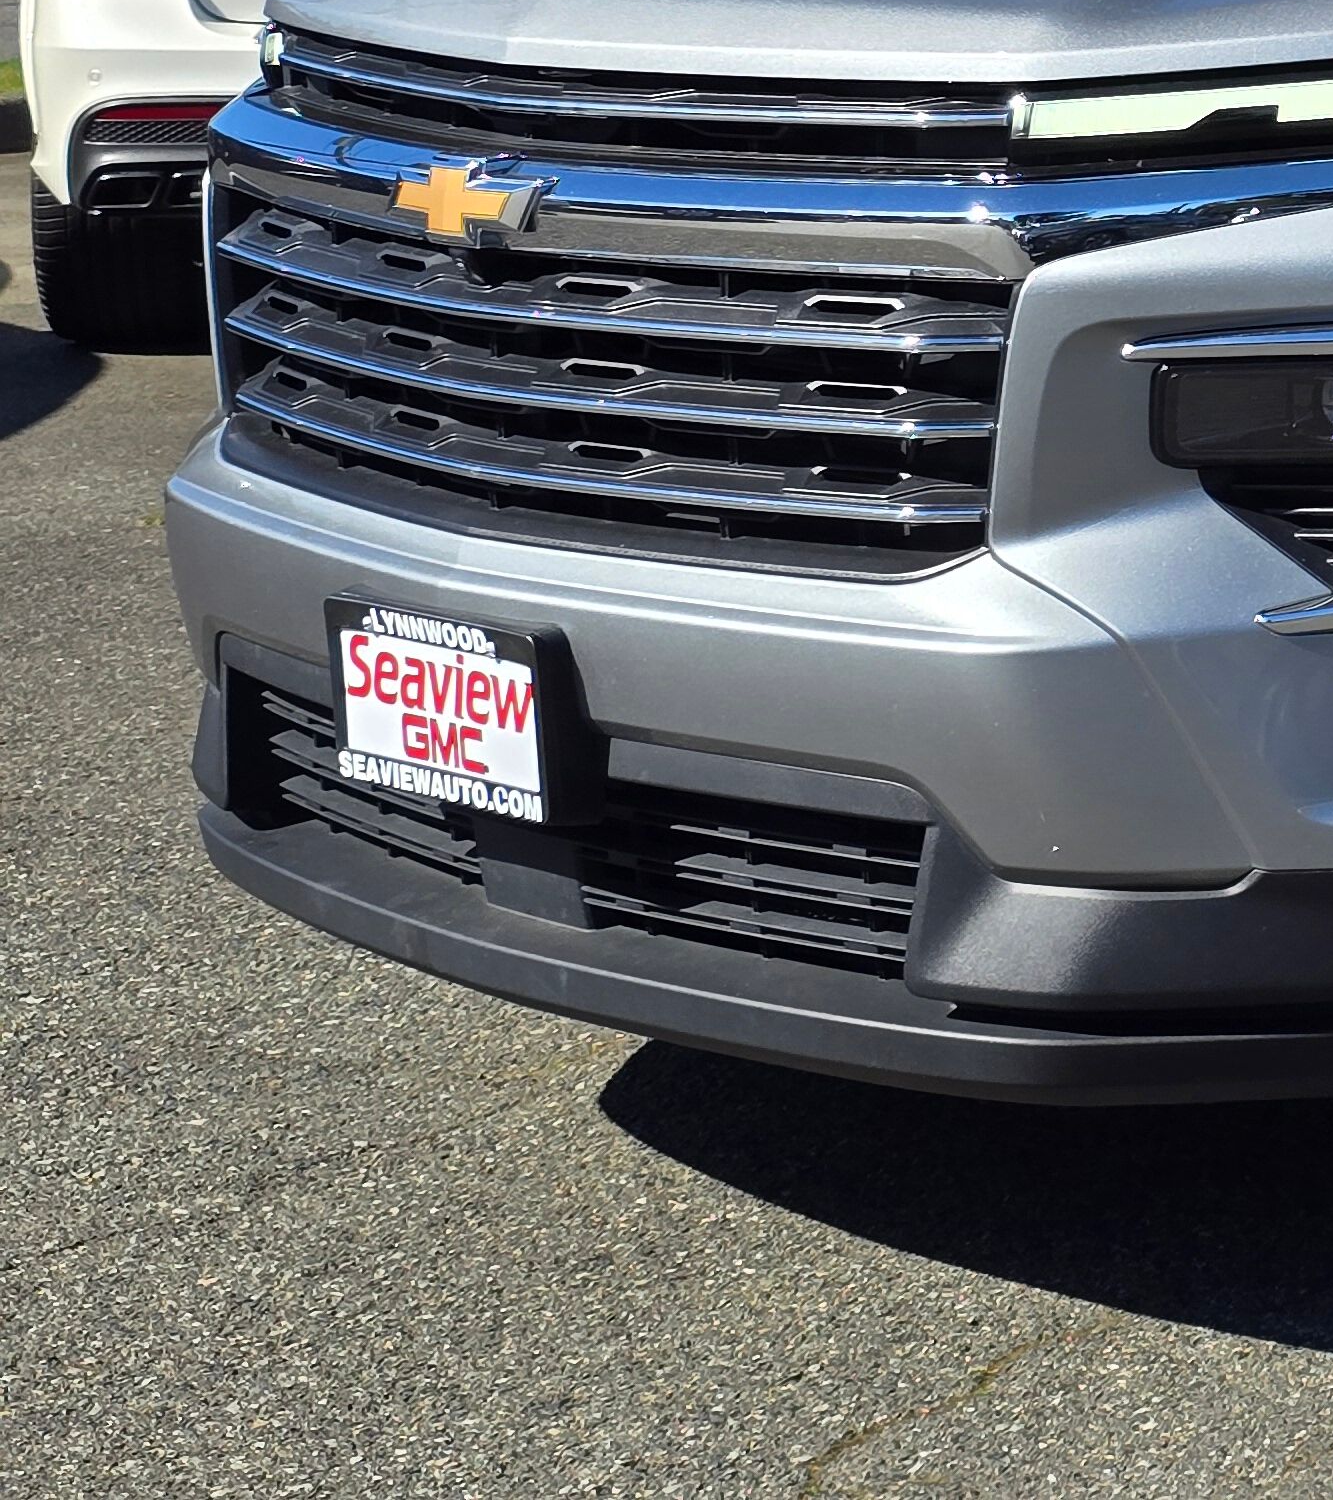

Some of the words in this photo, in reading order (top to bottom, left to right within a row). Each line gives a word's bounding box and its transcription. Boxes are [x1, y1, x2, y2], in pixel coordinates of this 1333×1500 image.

[369, 607, 487, 654] LYNNWOOD
[347, 634, 536, 734] Seaview
[402, 712, 489, 775] GMC
[338, 750, 543, 823] SEAVIEWAUTO.COM
